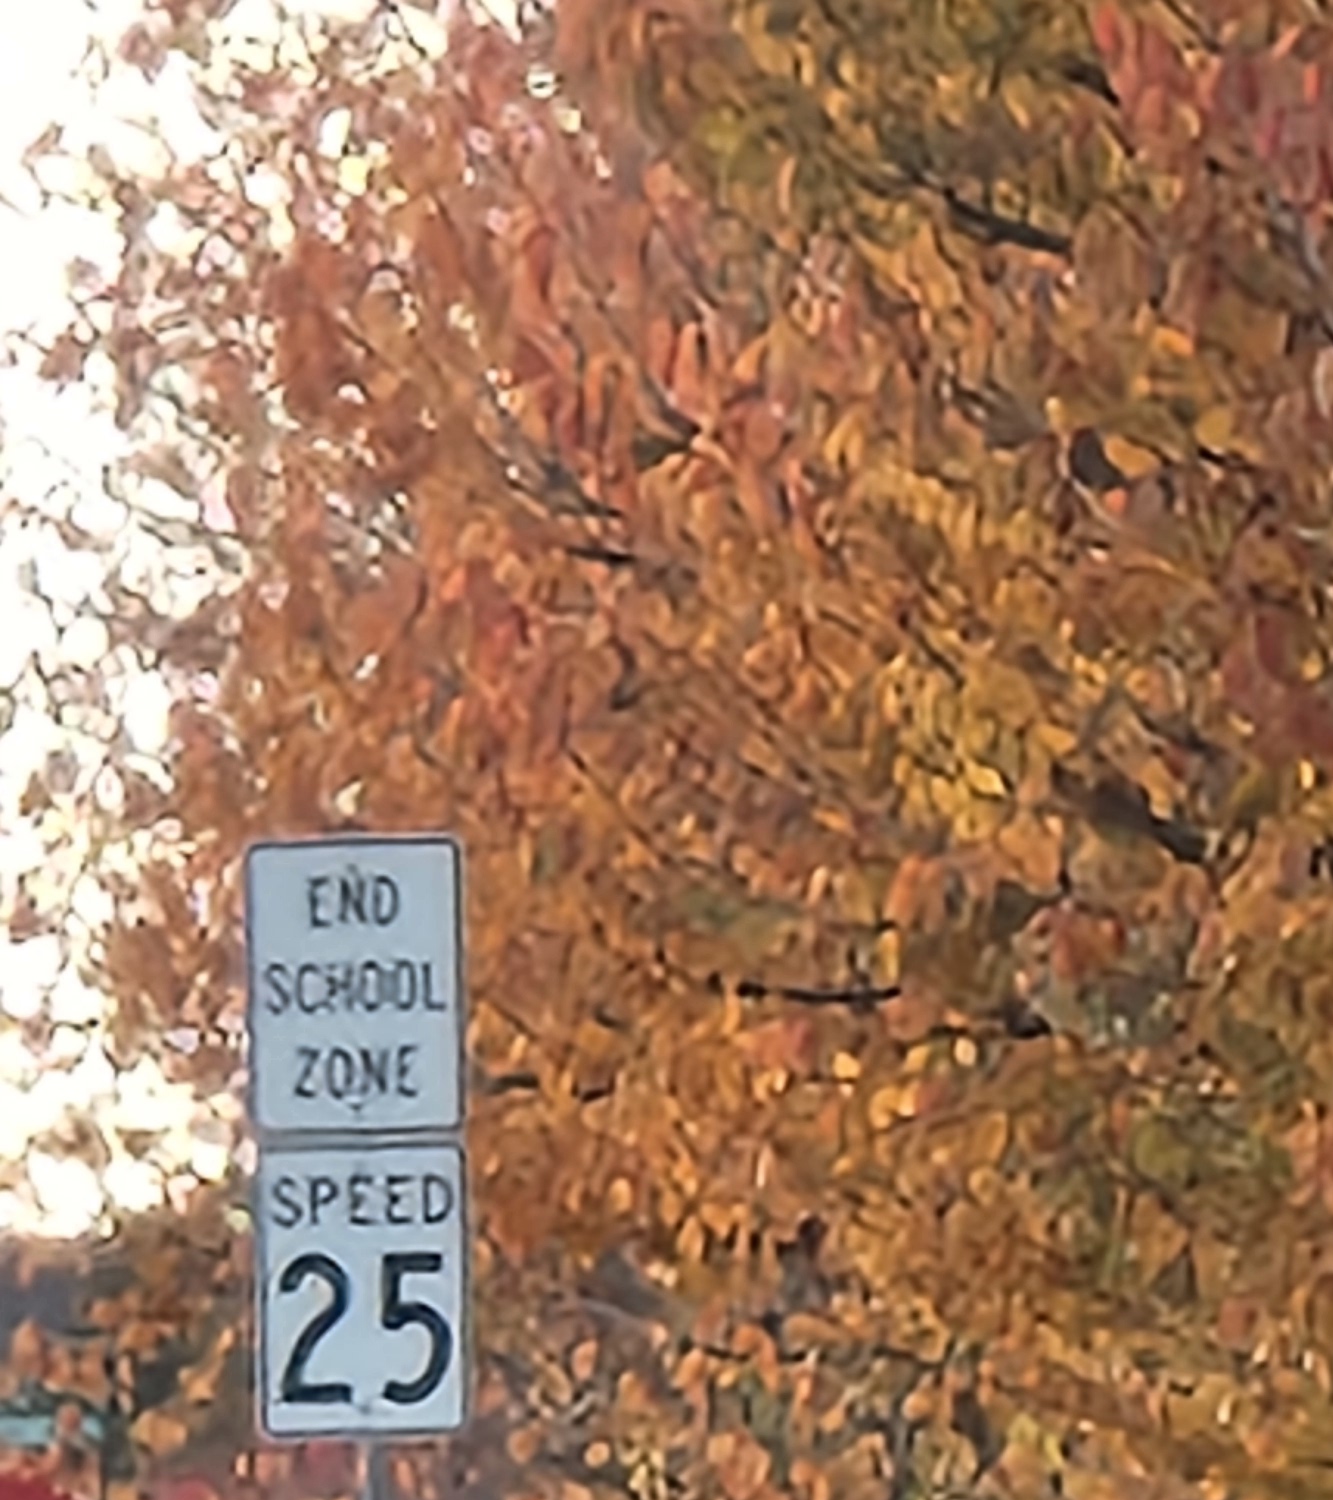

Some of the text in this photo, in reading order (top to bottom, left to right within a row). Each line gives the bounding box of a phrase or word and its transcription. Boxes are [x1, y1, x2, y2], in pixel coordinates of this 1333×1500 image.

[307, 873, 401, 929] END
[263, 959, 447, 1015] SCHOOL
[294, 1044, 420, 1099] ZONE
[272, 1174, 454, 1229] SPEED
[278, 1251, 454, 1405] 25
